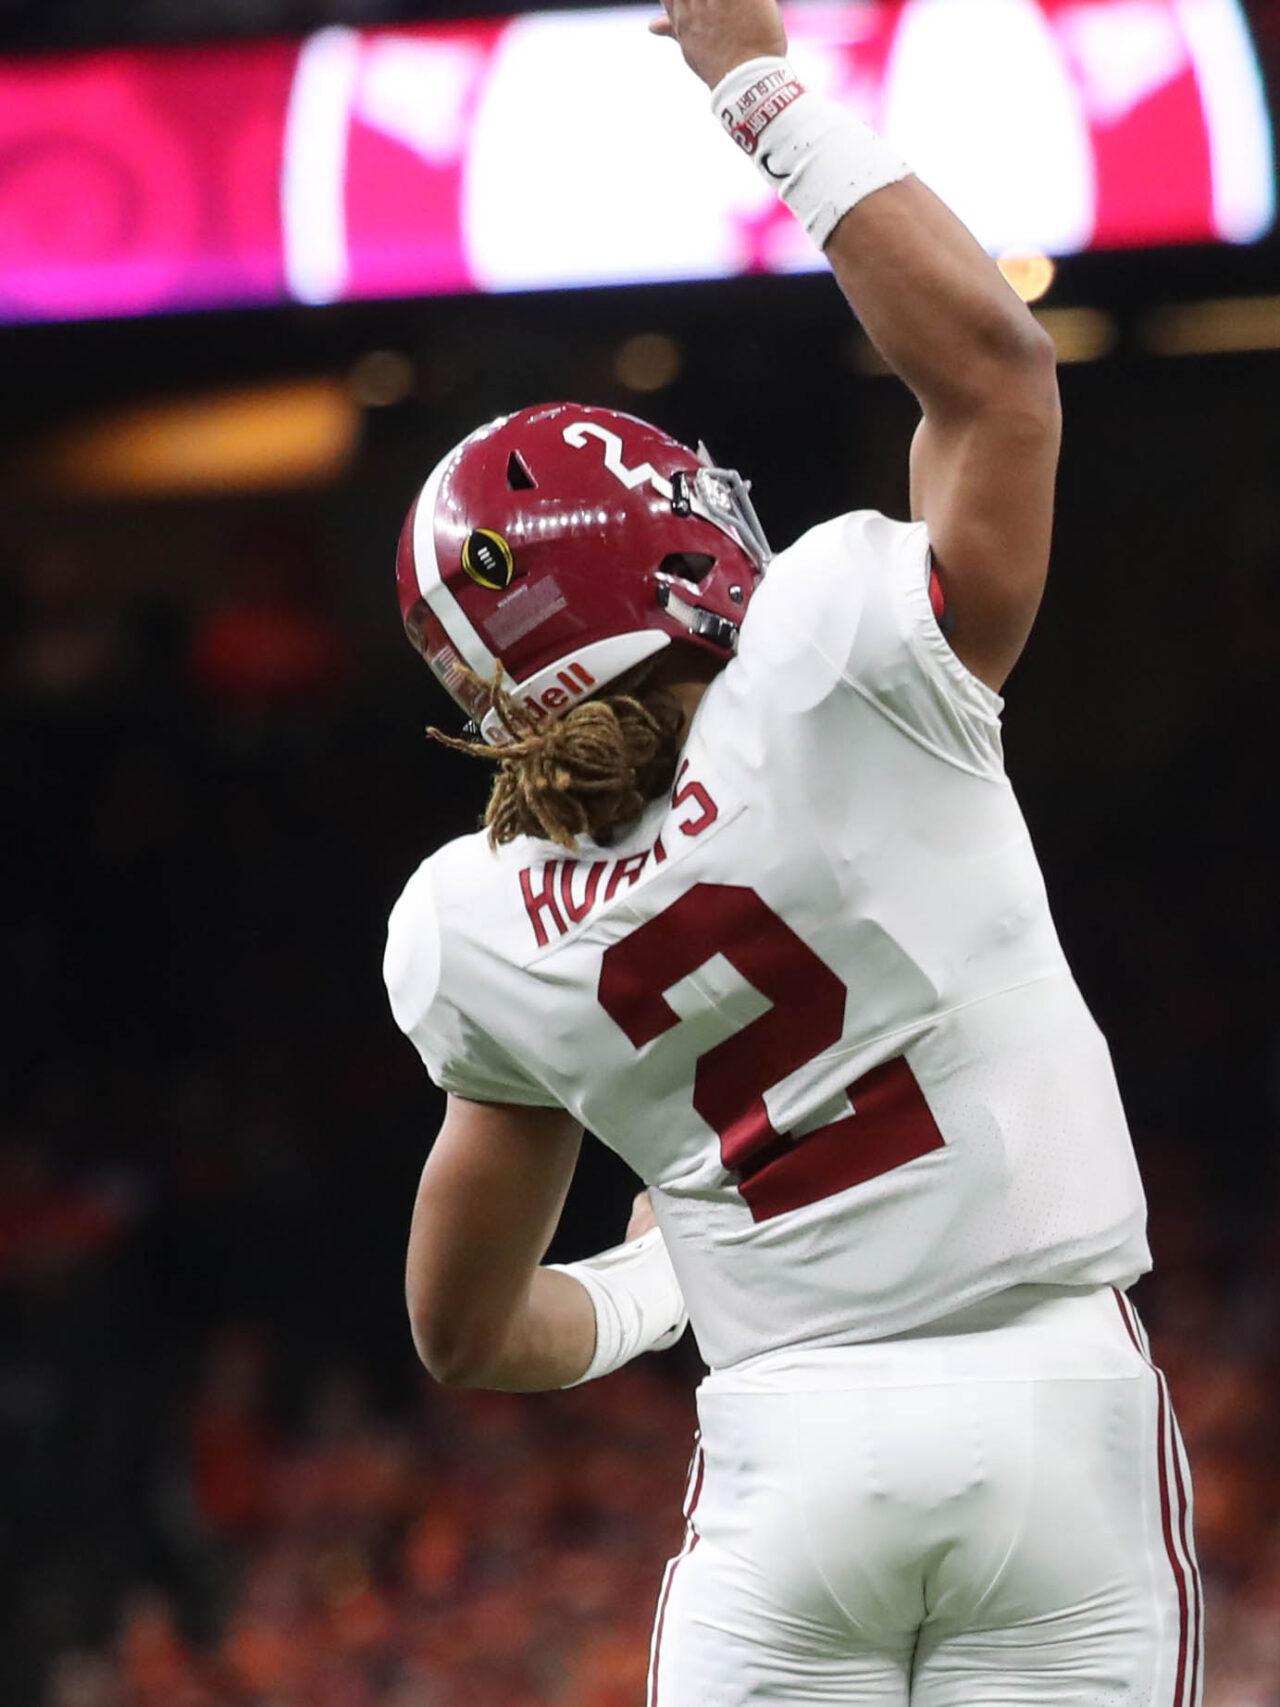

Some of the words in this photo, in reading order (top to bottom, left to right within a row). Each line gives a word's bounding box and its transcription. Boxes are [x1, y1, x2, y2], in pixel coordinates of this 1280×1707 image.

[562, 421, 675, 500] 2
[519, 758, 718, 948] HURS
[597, 882, 946, 1223] 2
